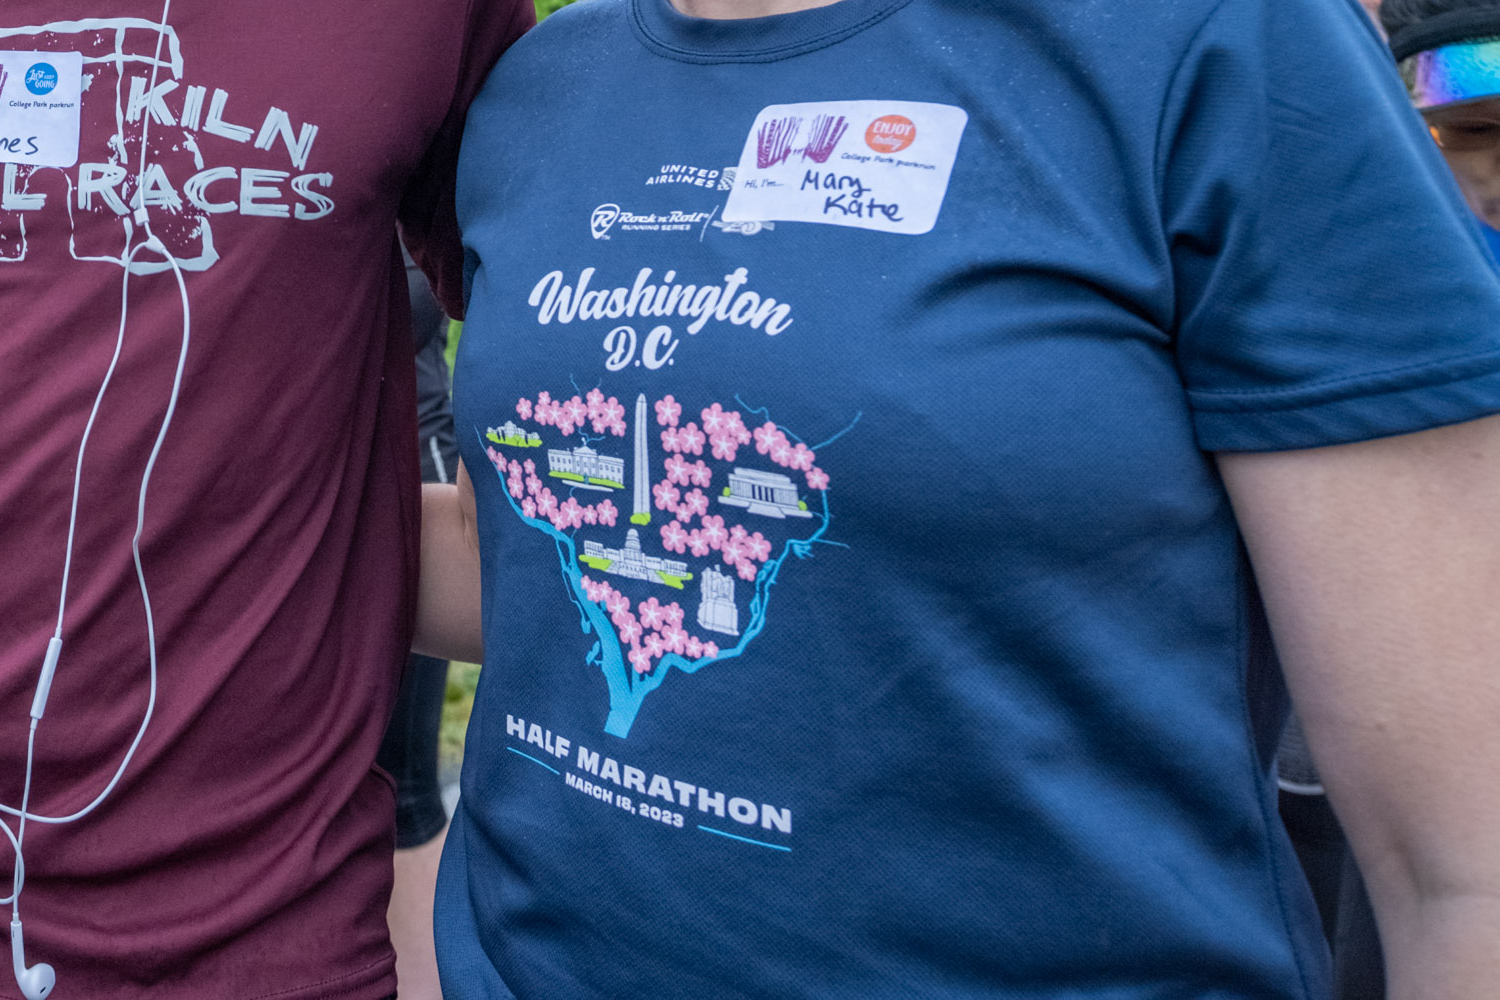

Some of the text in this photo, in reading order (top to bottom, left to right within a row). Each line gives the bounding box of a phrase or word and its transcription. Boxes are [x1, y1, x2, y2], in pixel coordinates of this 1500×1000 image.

[34, 80, 55, 89] GOING
[9, 100, 32, 109] College
[49, 102, 74, 110] parkrun
[125, 76, 319, 171] KILN
[873, 121, 913, 136] ENJOY
[841, 152, 871, 163] College
[874, 155, 894, 163] Park
[645, 175, 715, 189] AIRLINES
[660, 164, 719, 179] UNITED
[77, 162, 335, 221] RACES
[744, 179, 758, 190] Hi,
[800, 169, 872, 198] Mary
[618, 212, 656, 223] Rock
[823, 194, 904, 222] Kate
[528, 267, 793, 336] Washington
[603, 325, 679, 371] D.C.
[506, 714, 792, 834] HALF MARATHON
[565, 772, 684, 828] MARCH 18, 2023
